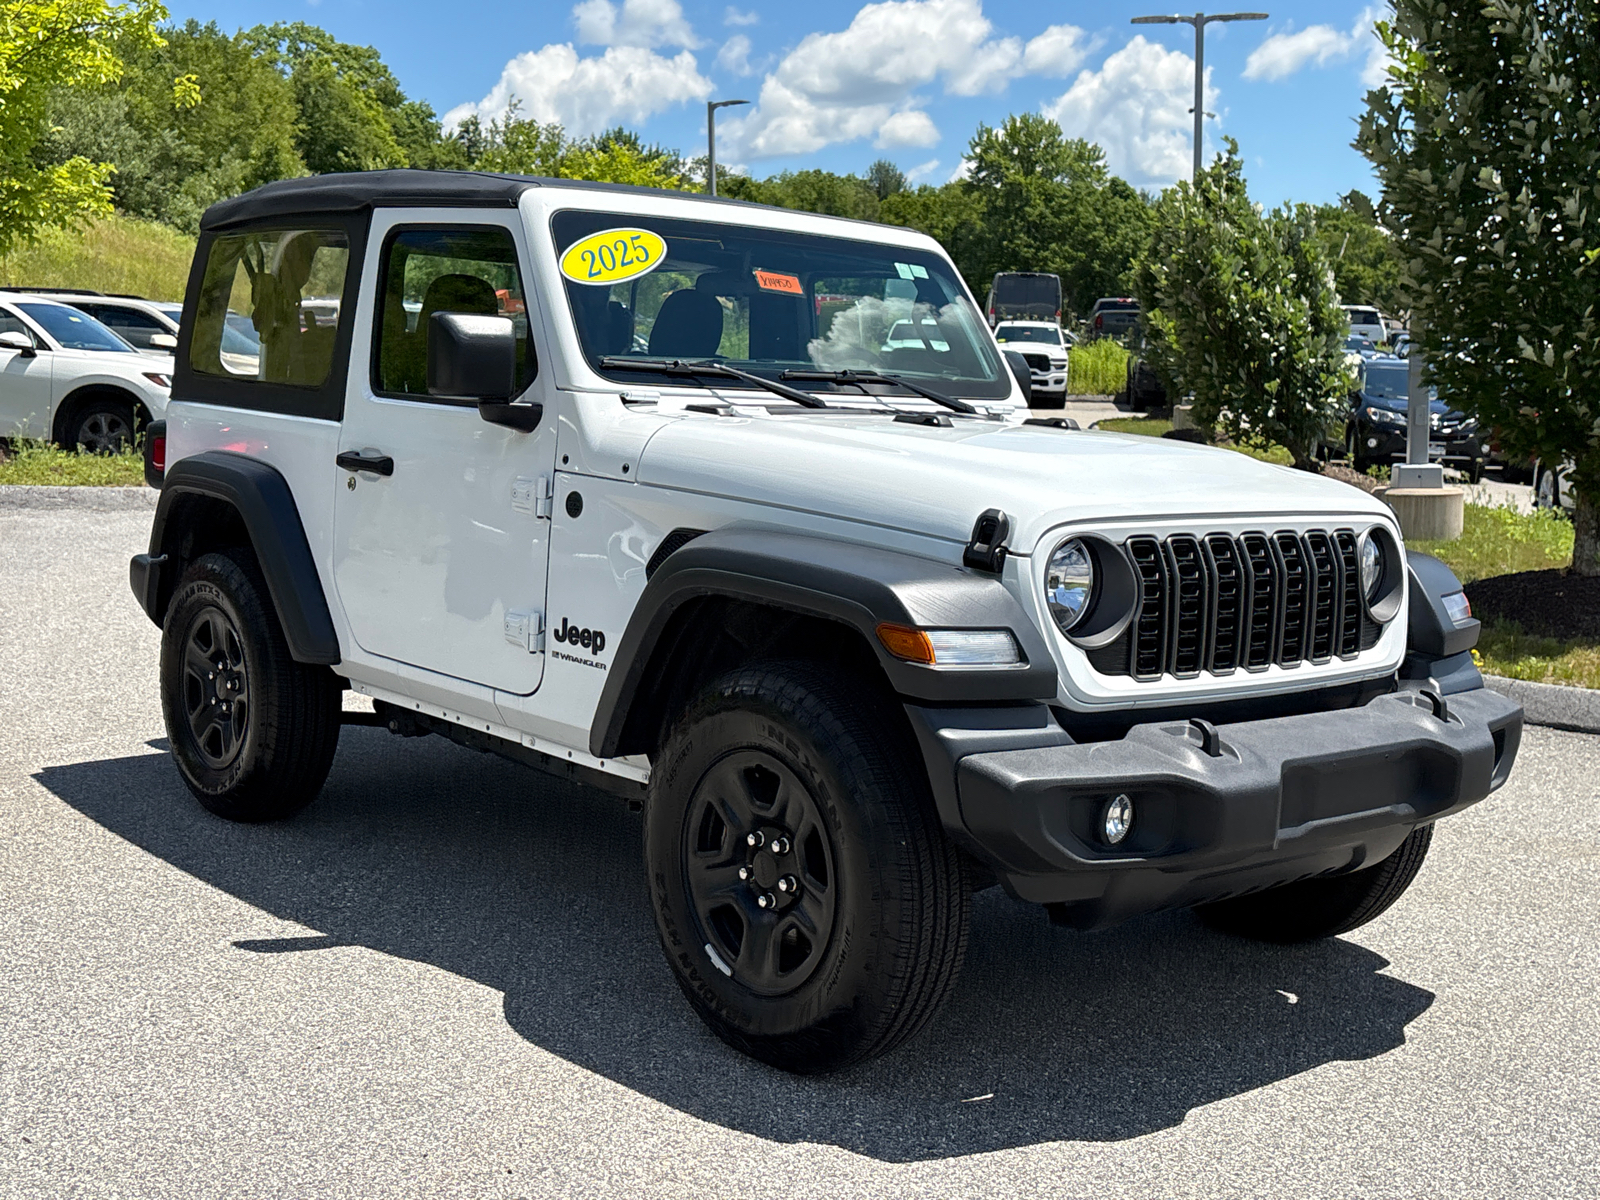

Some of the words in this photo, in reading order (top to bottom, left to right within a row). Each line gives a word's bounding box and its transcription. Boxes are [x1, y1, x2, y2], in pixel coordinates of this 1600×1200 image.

[580, 234, 650, 278] 2025
[554, 617, 606, 655] Jeep
[559, 653, 607, 670] WRANGLER
[767, 723, 842, 832] NEXEN
